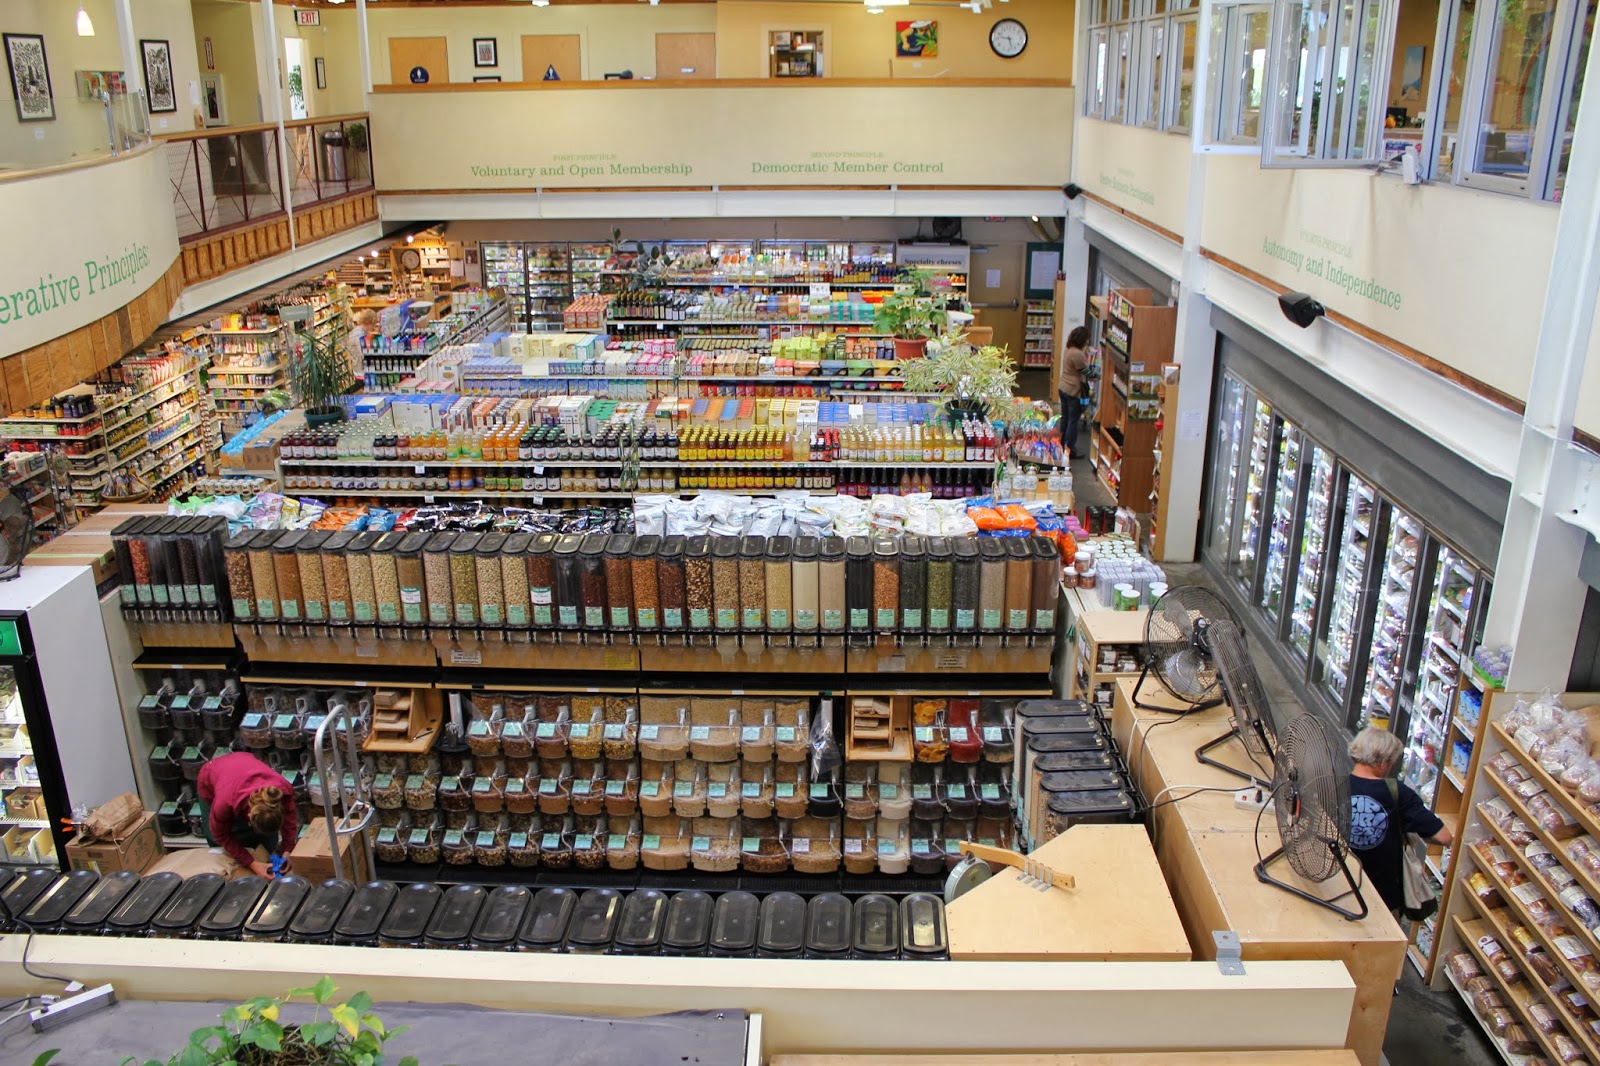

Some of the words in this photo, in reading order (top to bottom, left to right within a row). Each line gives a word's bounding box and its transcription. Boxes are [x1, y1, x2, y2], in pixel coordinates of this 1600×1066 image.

[301, 12, 316, 24] EXIT
[470, 165, 536, 178] Voluntary
[540, 165, 565, 176] and
[569, 164, 604, 178] Open
[610, 163, 693, 176] Membership
[752, 162, 829, 173] Democratic
[834, 162, 888, 173] Member
[893, 162, 943, 173] Control
[904, 258, 935, 266] Specialty
[1262, 236, 1305, 272] Autonomy
[1306, 258, 1324, 277] and
[1326, 261, 1402, 311] Independence
